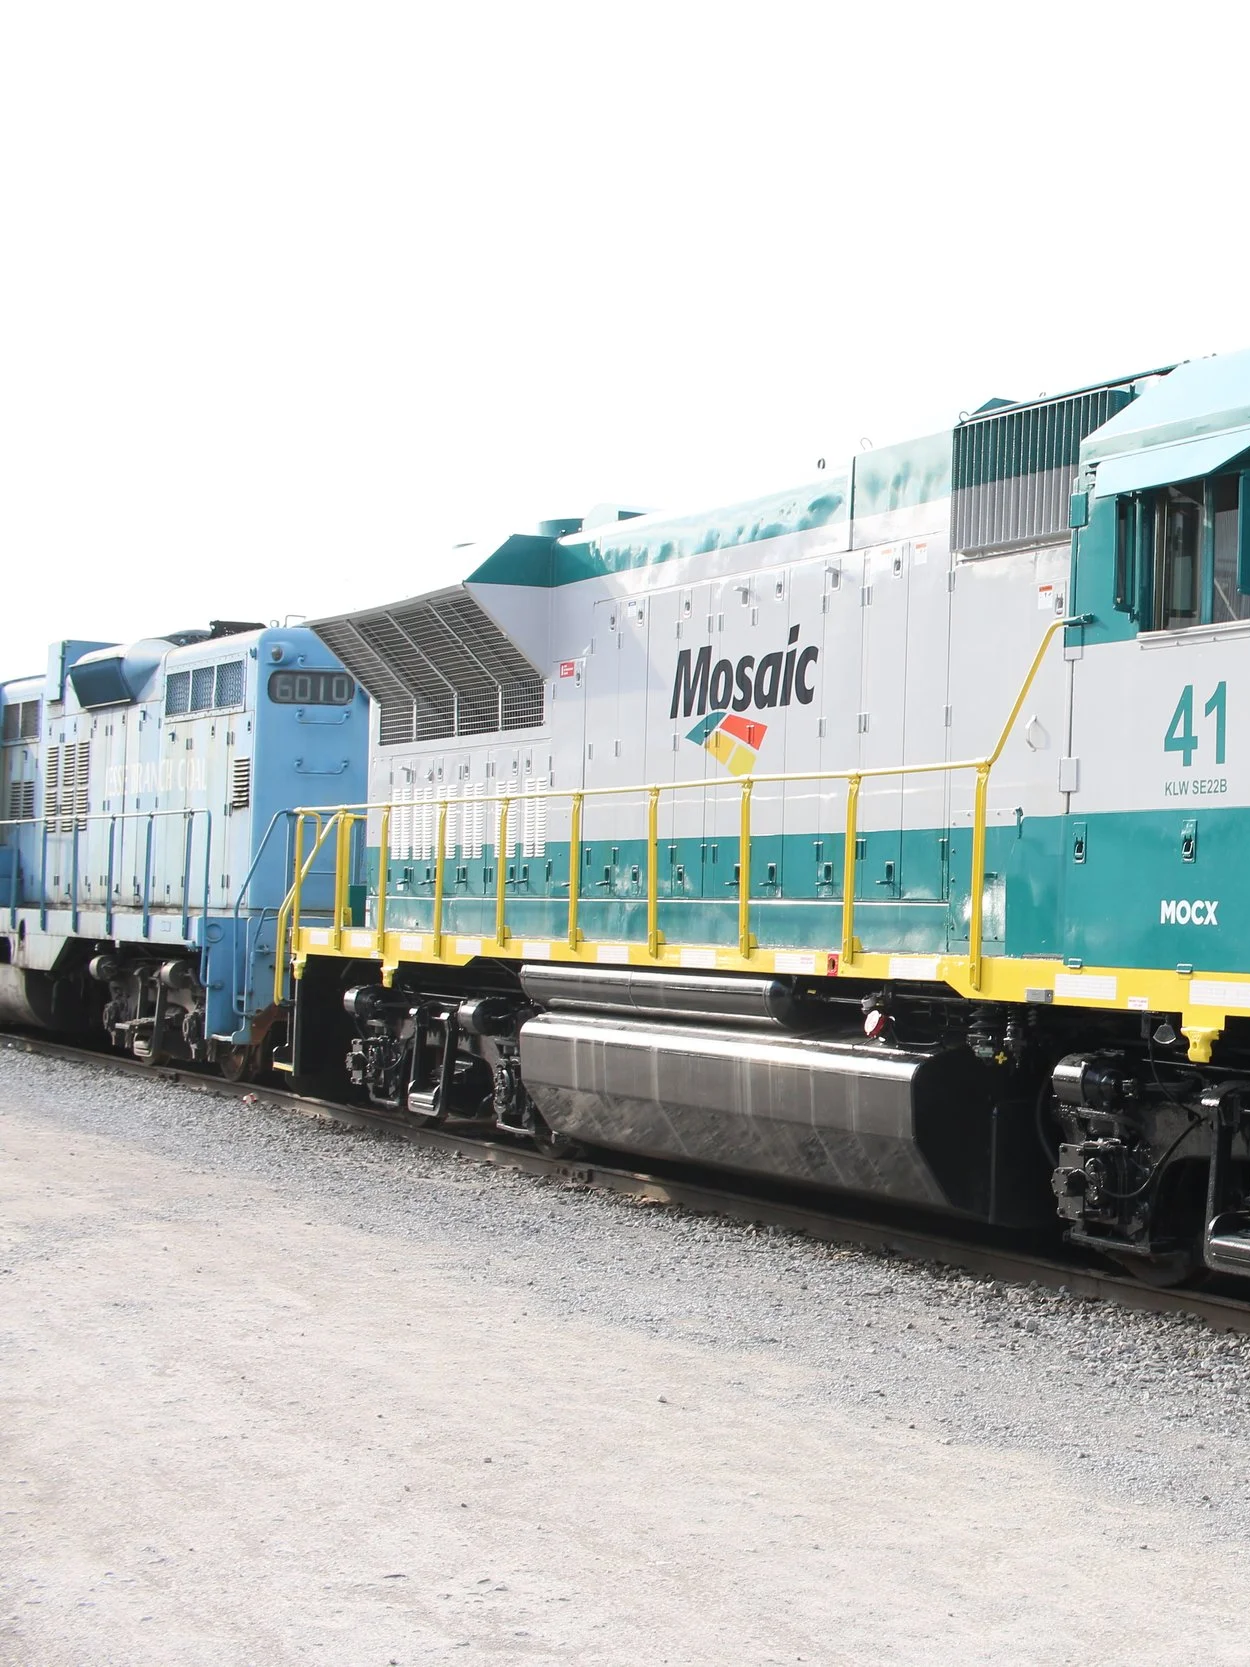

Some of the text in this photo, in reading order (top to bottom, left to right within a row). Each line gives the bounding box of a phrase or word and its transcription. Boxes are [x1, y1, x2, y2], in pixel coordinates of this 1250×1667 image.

[670, 623, 819, 719] Mosaic
[276, 674, 349, 701] 6010
[1164, 681, 1227, 767] 41
[1165, 779, 1227, 796] KLW SE22B
[1160, 899, 1219, 926] MOCX
